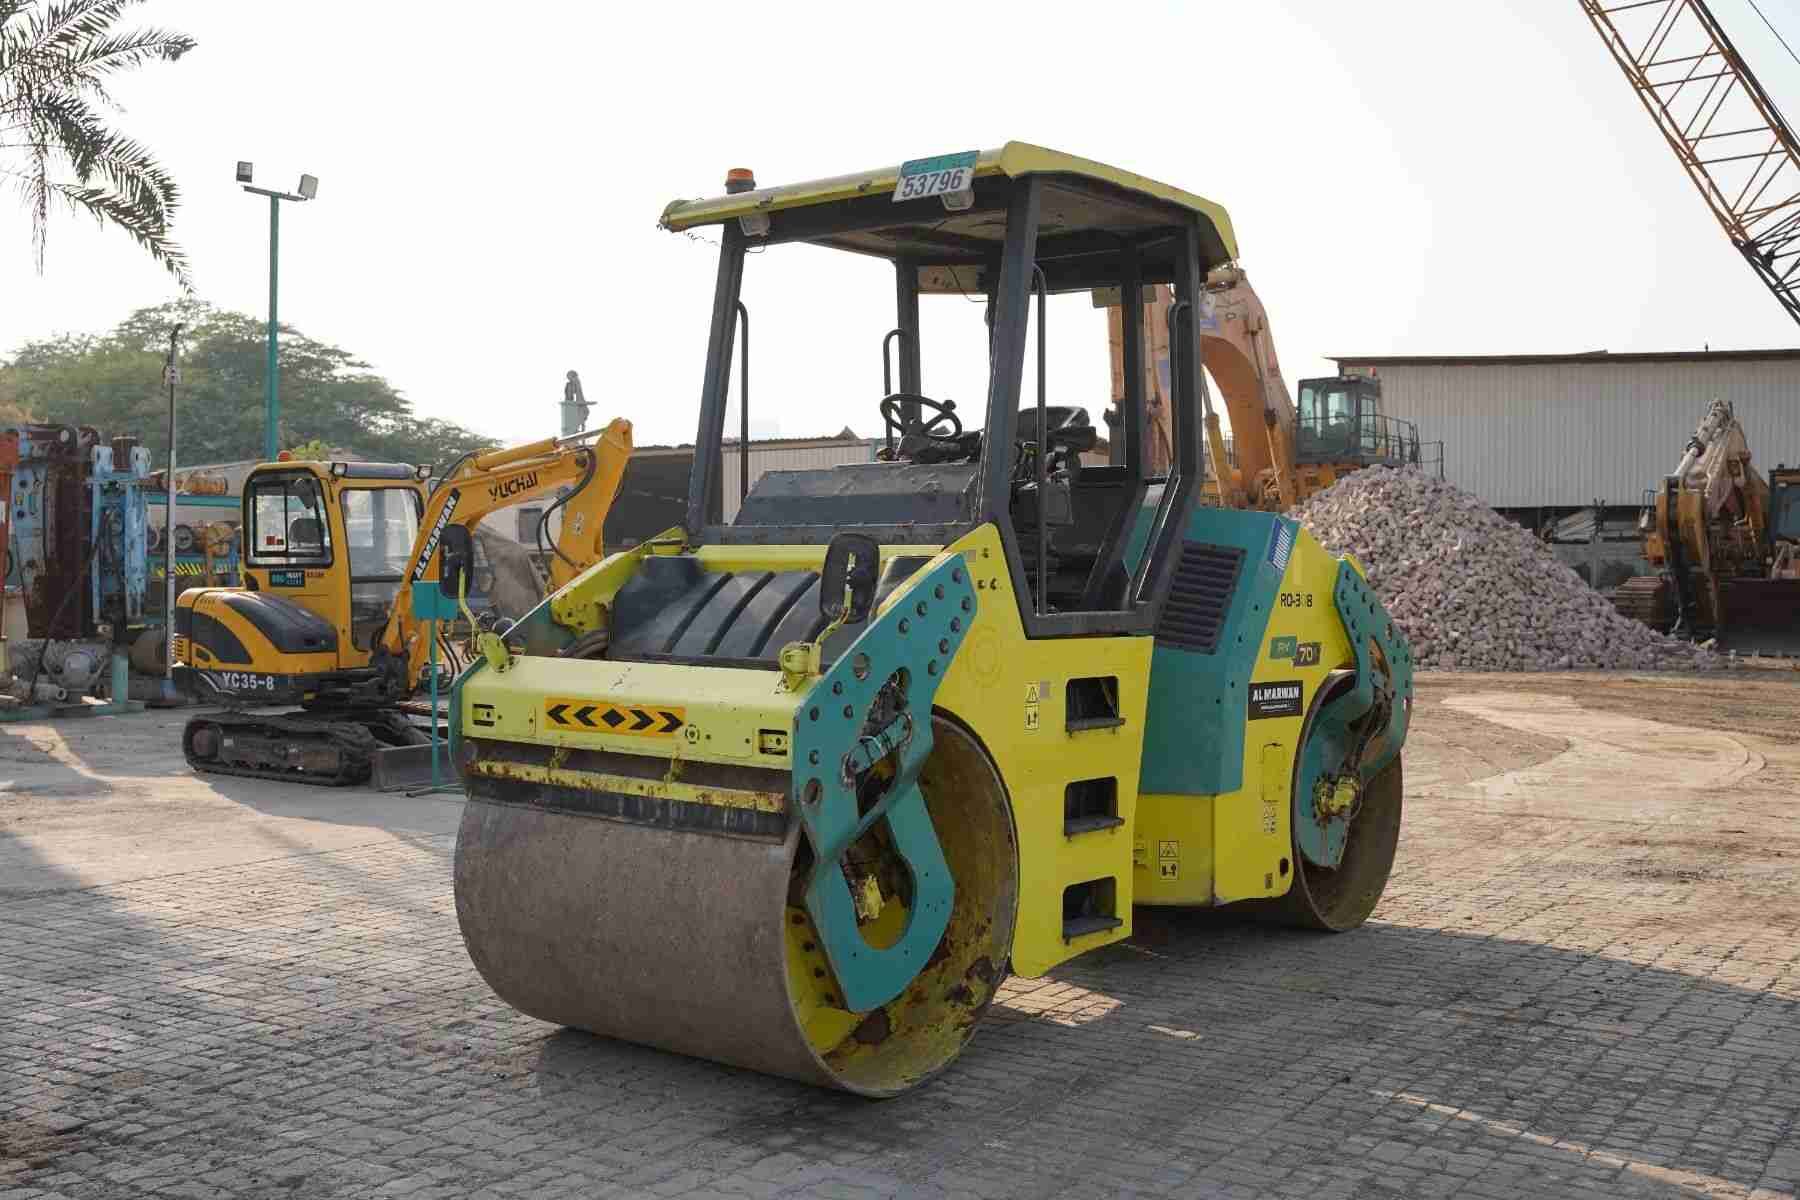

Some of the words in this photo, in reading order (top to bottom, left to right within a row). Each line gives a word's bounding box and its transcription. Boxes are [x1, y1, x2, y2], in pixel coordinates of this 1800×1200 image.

[903, 169, 963, 197] 53796
[488, 471, 539, 501] YUCHAI
[222, 672, 275, 690] YC35-8
[1252, 689, 1264, 702] AL
[1263, 686, 1300, 701] MARWAN
